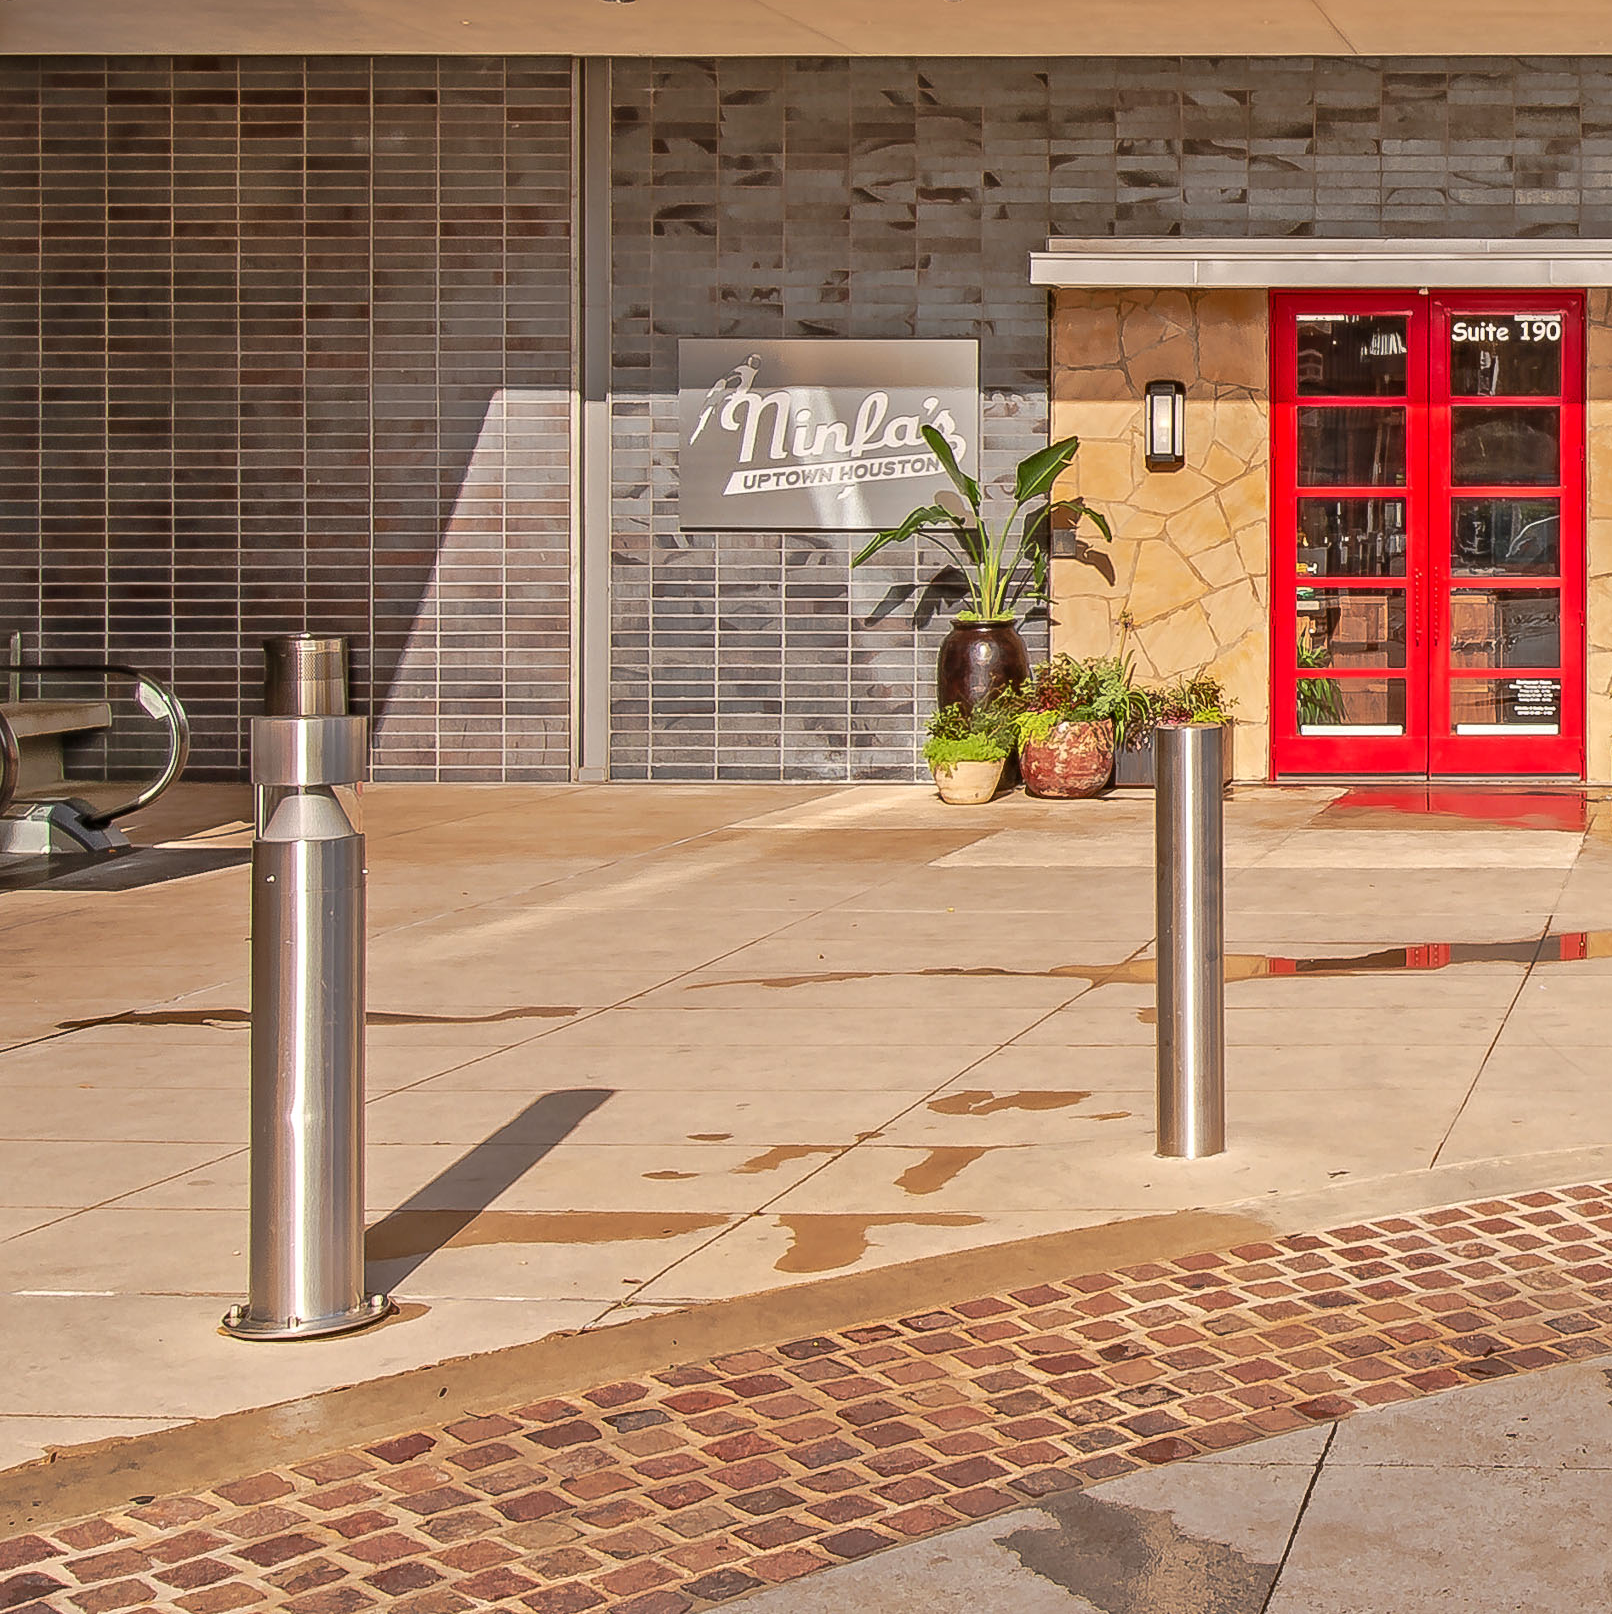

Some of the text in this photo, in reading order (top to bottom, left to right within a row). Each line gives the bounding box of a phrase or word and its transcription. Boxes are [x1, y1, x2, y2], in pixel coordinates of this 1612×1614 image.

[1451, 321, 1561, 342] Suite 190
[720, 390, 967, 465] Ninfa's
[742, 456, 940, 490] UPTOWN HOUSTON
